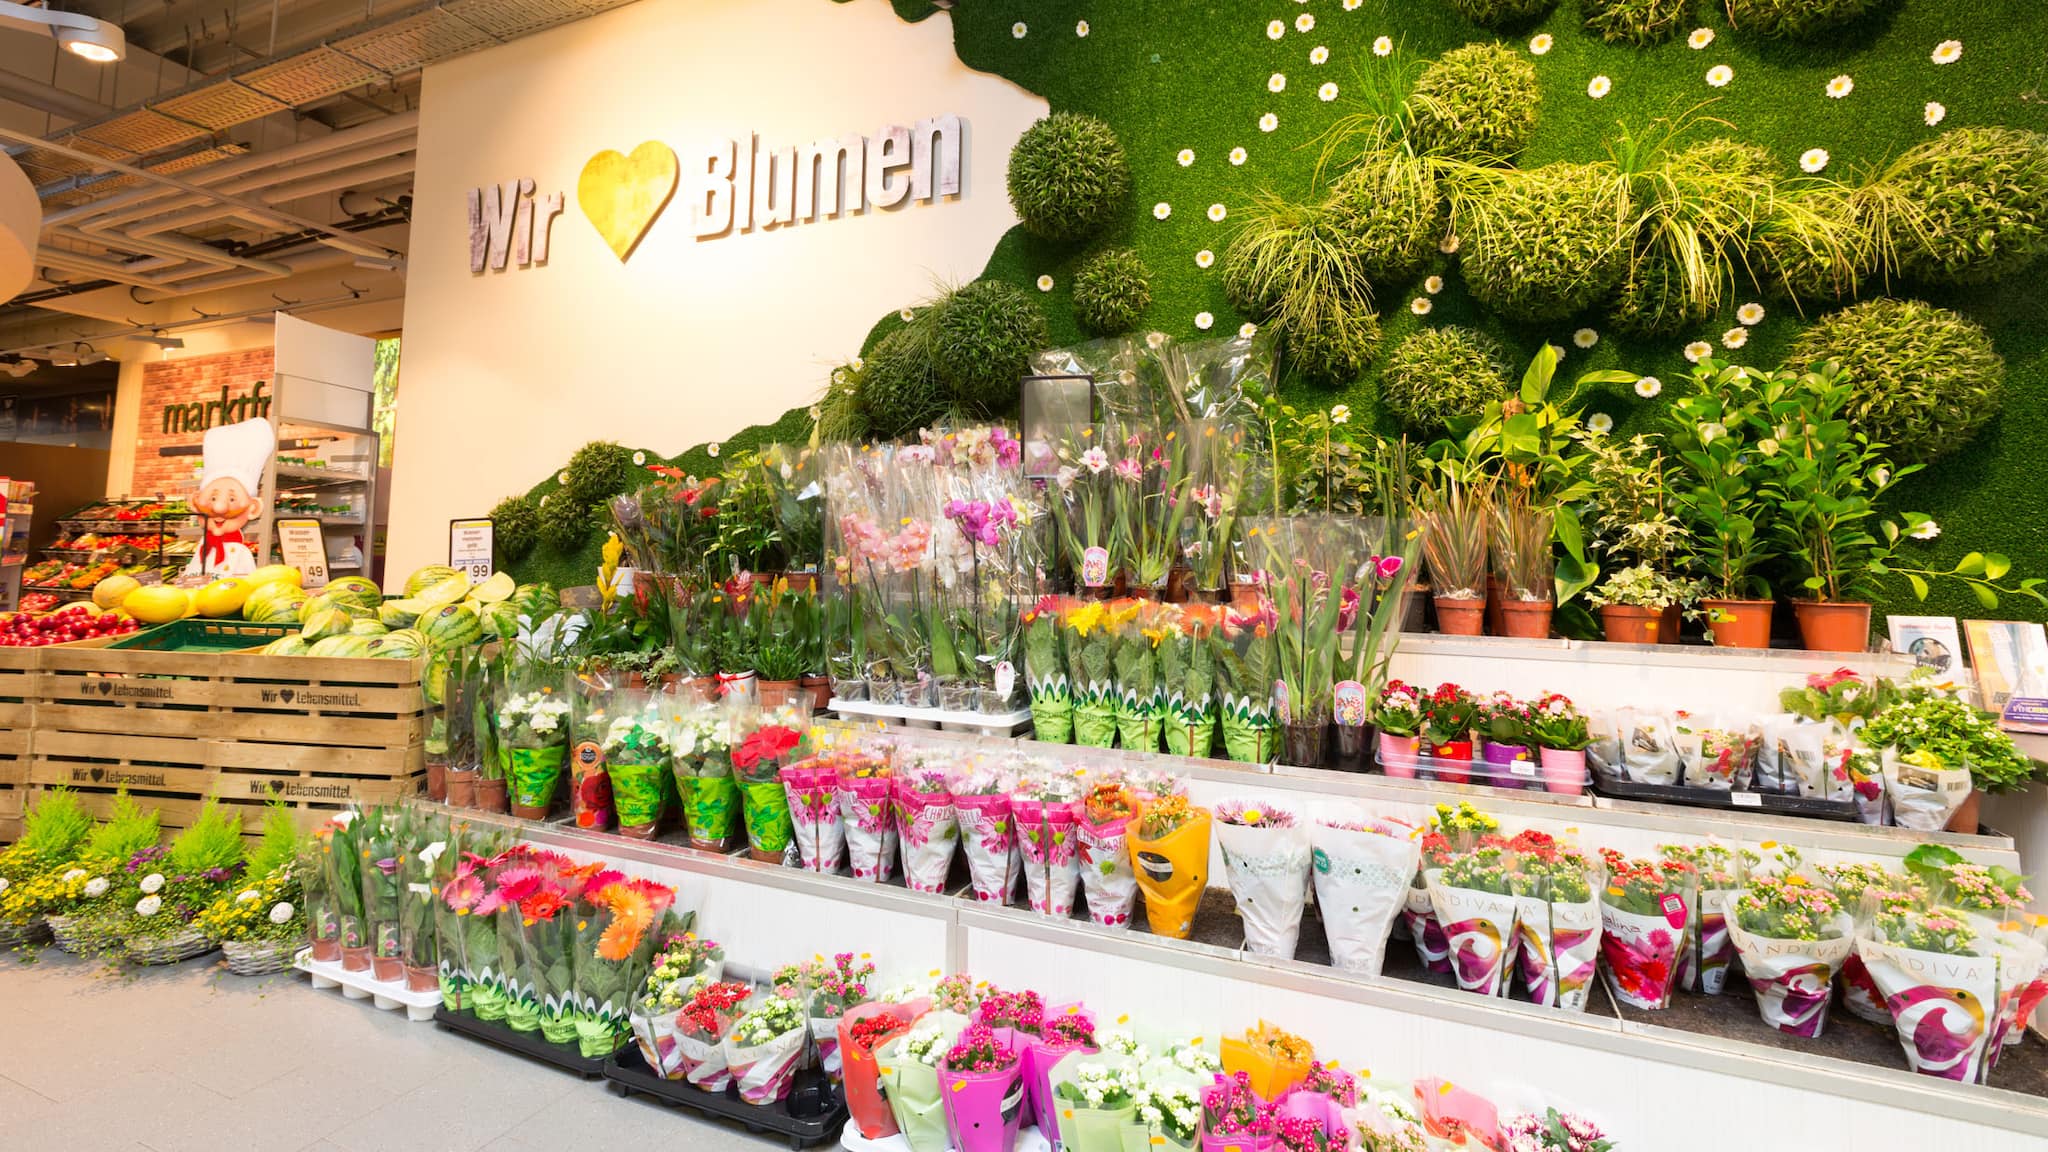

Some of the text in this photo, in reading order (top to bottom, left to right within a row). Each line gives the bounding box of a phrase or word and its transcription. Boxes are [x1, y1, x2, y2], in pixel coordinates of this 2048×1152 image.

[467, 112, 962, 273] Wir Blumen
[308, 565, 323, 577] 49
[472, 565, 488, 577] 99
[81, 681, 96, 695] Wir
[261, 689, 278, 703] Wir
[72, 767, 88, 781] Wir
